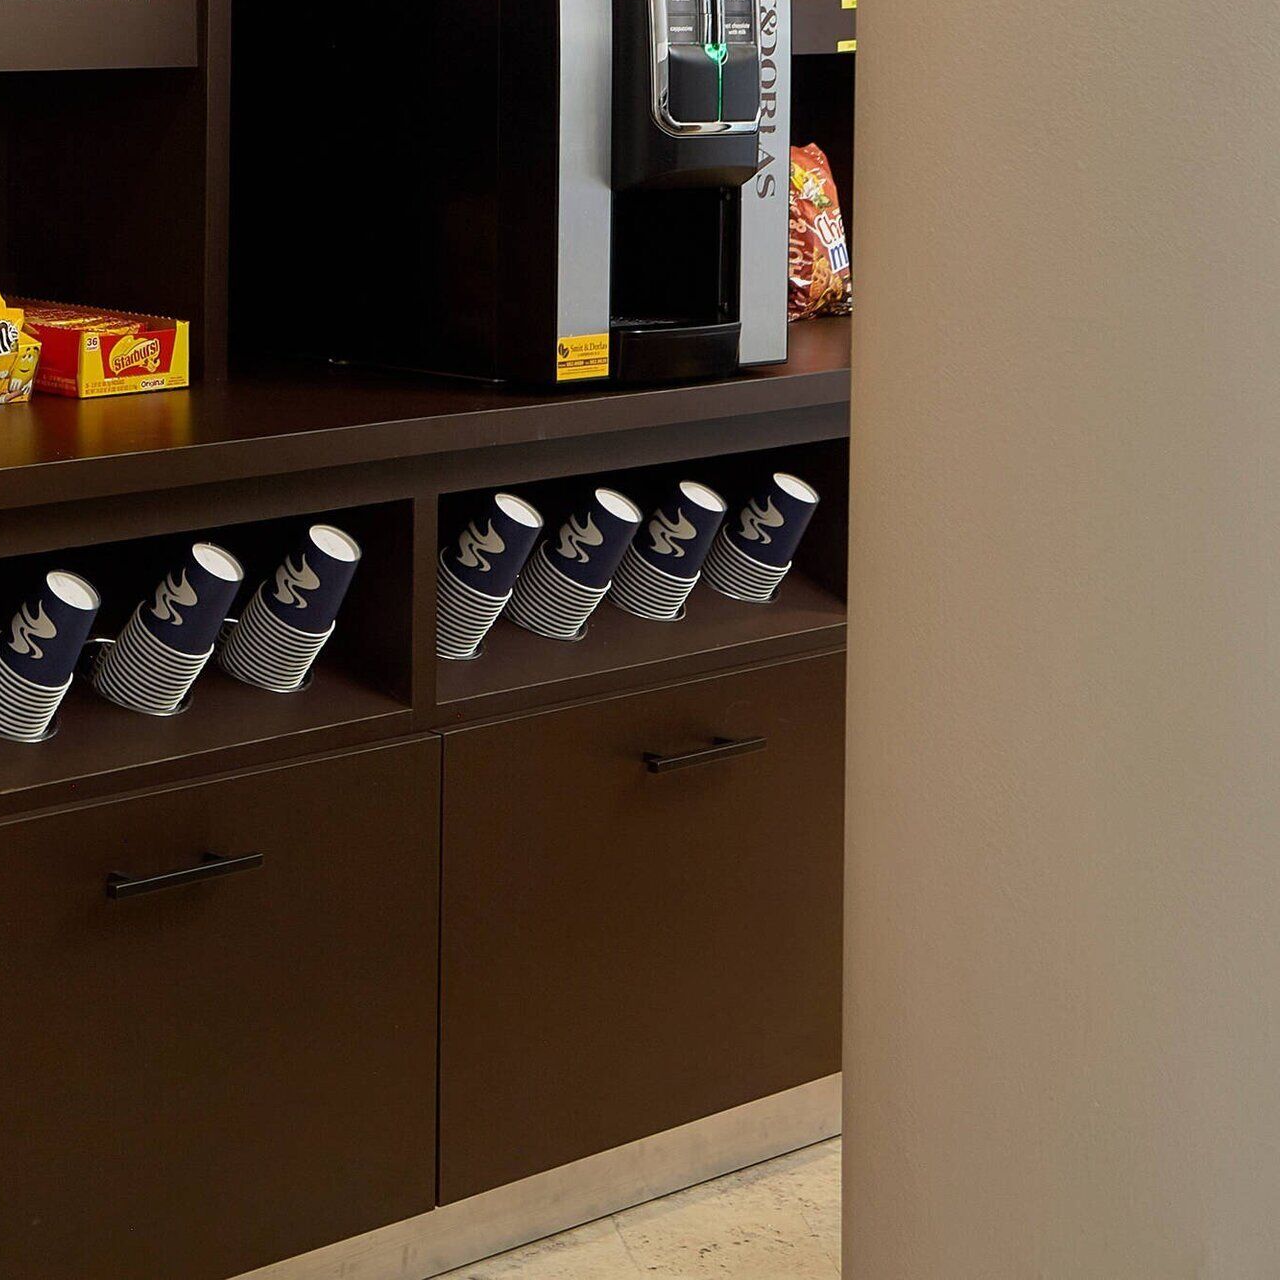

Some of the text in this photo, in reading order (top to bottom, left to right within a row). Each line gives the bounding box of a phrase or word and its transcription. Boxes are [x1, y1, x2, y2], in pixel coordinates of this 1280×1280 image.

[86, 337, 98, 347] 36
[113, 337, 159, 372] Starburst
[140, 378, 166, 389] Original
